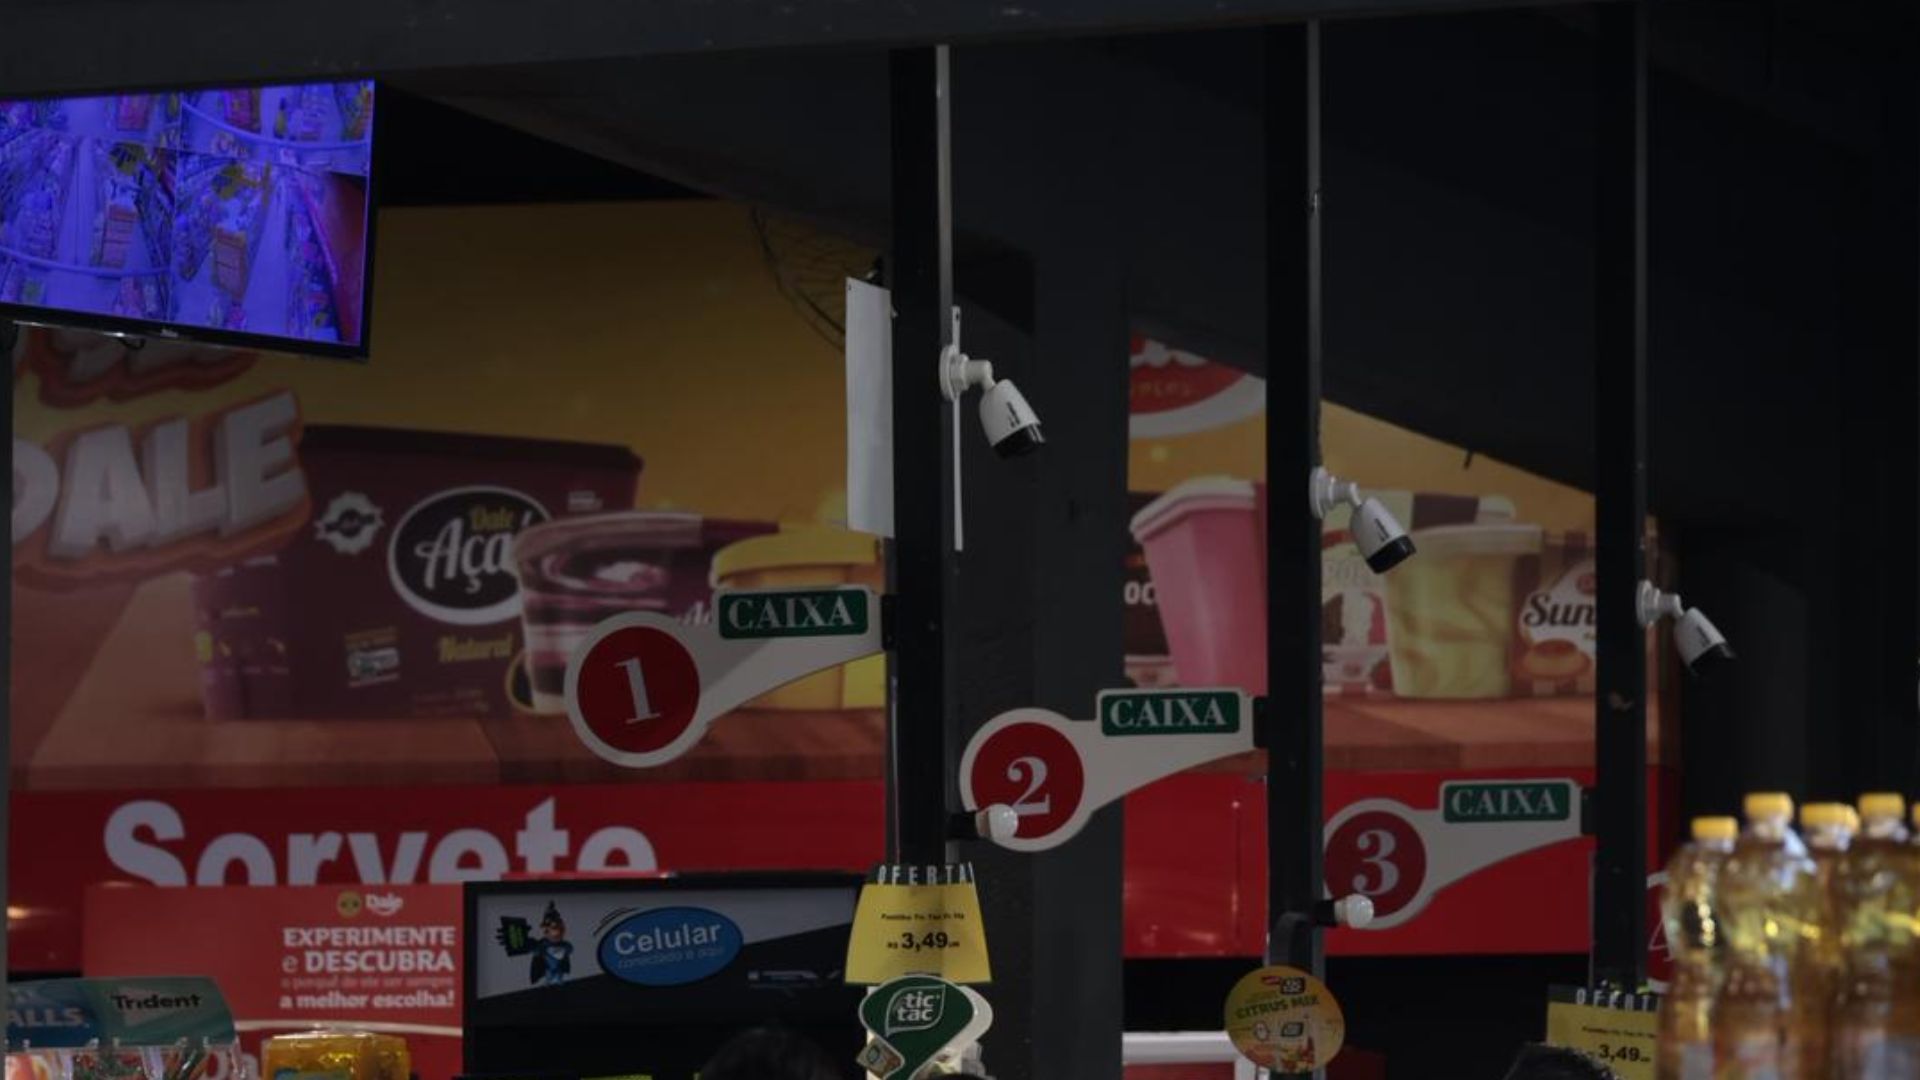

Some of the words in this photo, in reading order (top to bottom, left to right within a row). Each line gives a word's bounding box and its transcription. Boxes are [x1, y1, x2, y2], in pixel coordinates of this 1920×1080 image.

[727, 594, 857, 631] CAIXA
[613, 656, 662, 725] 1
[1109, 697, 1227, 728] CAIXA
[1006, 756, 1050, 816] 2
[1451, 788, 1558, 816] CAIXA
[103, 796, 659, 887] Sorvete
[1352, 829, 1399, 895] 3
[282, 927, 456, 948] EXPERIMENTE
[614, 922, 721, 955] Celular
[902, 932, 948, 952] 3,49
[281, 956, 299, 973] e
[305, 950, 455, 973] DESCUBRA
[110, 993, 201, 1011] Trident
[279, 995, 294, 1008] a
[297, 989, 369, 1008] melhor
[373, 989, 455, 1008] escolha!
[904, 990, 934, 1006] tic
[897, 1006, 933, 1021] tac
